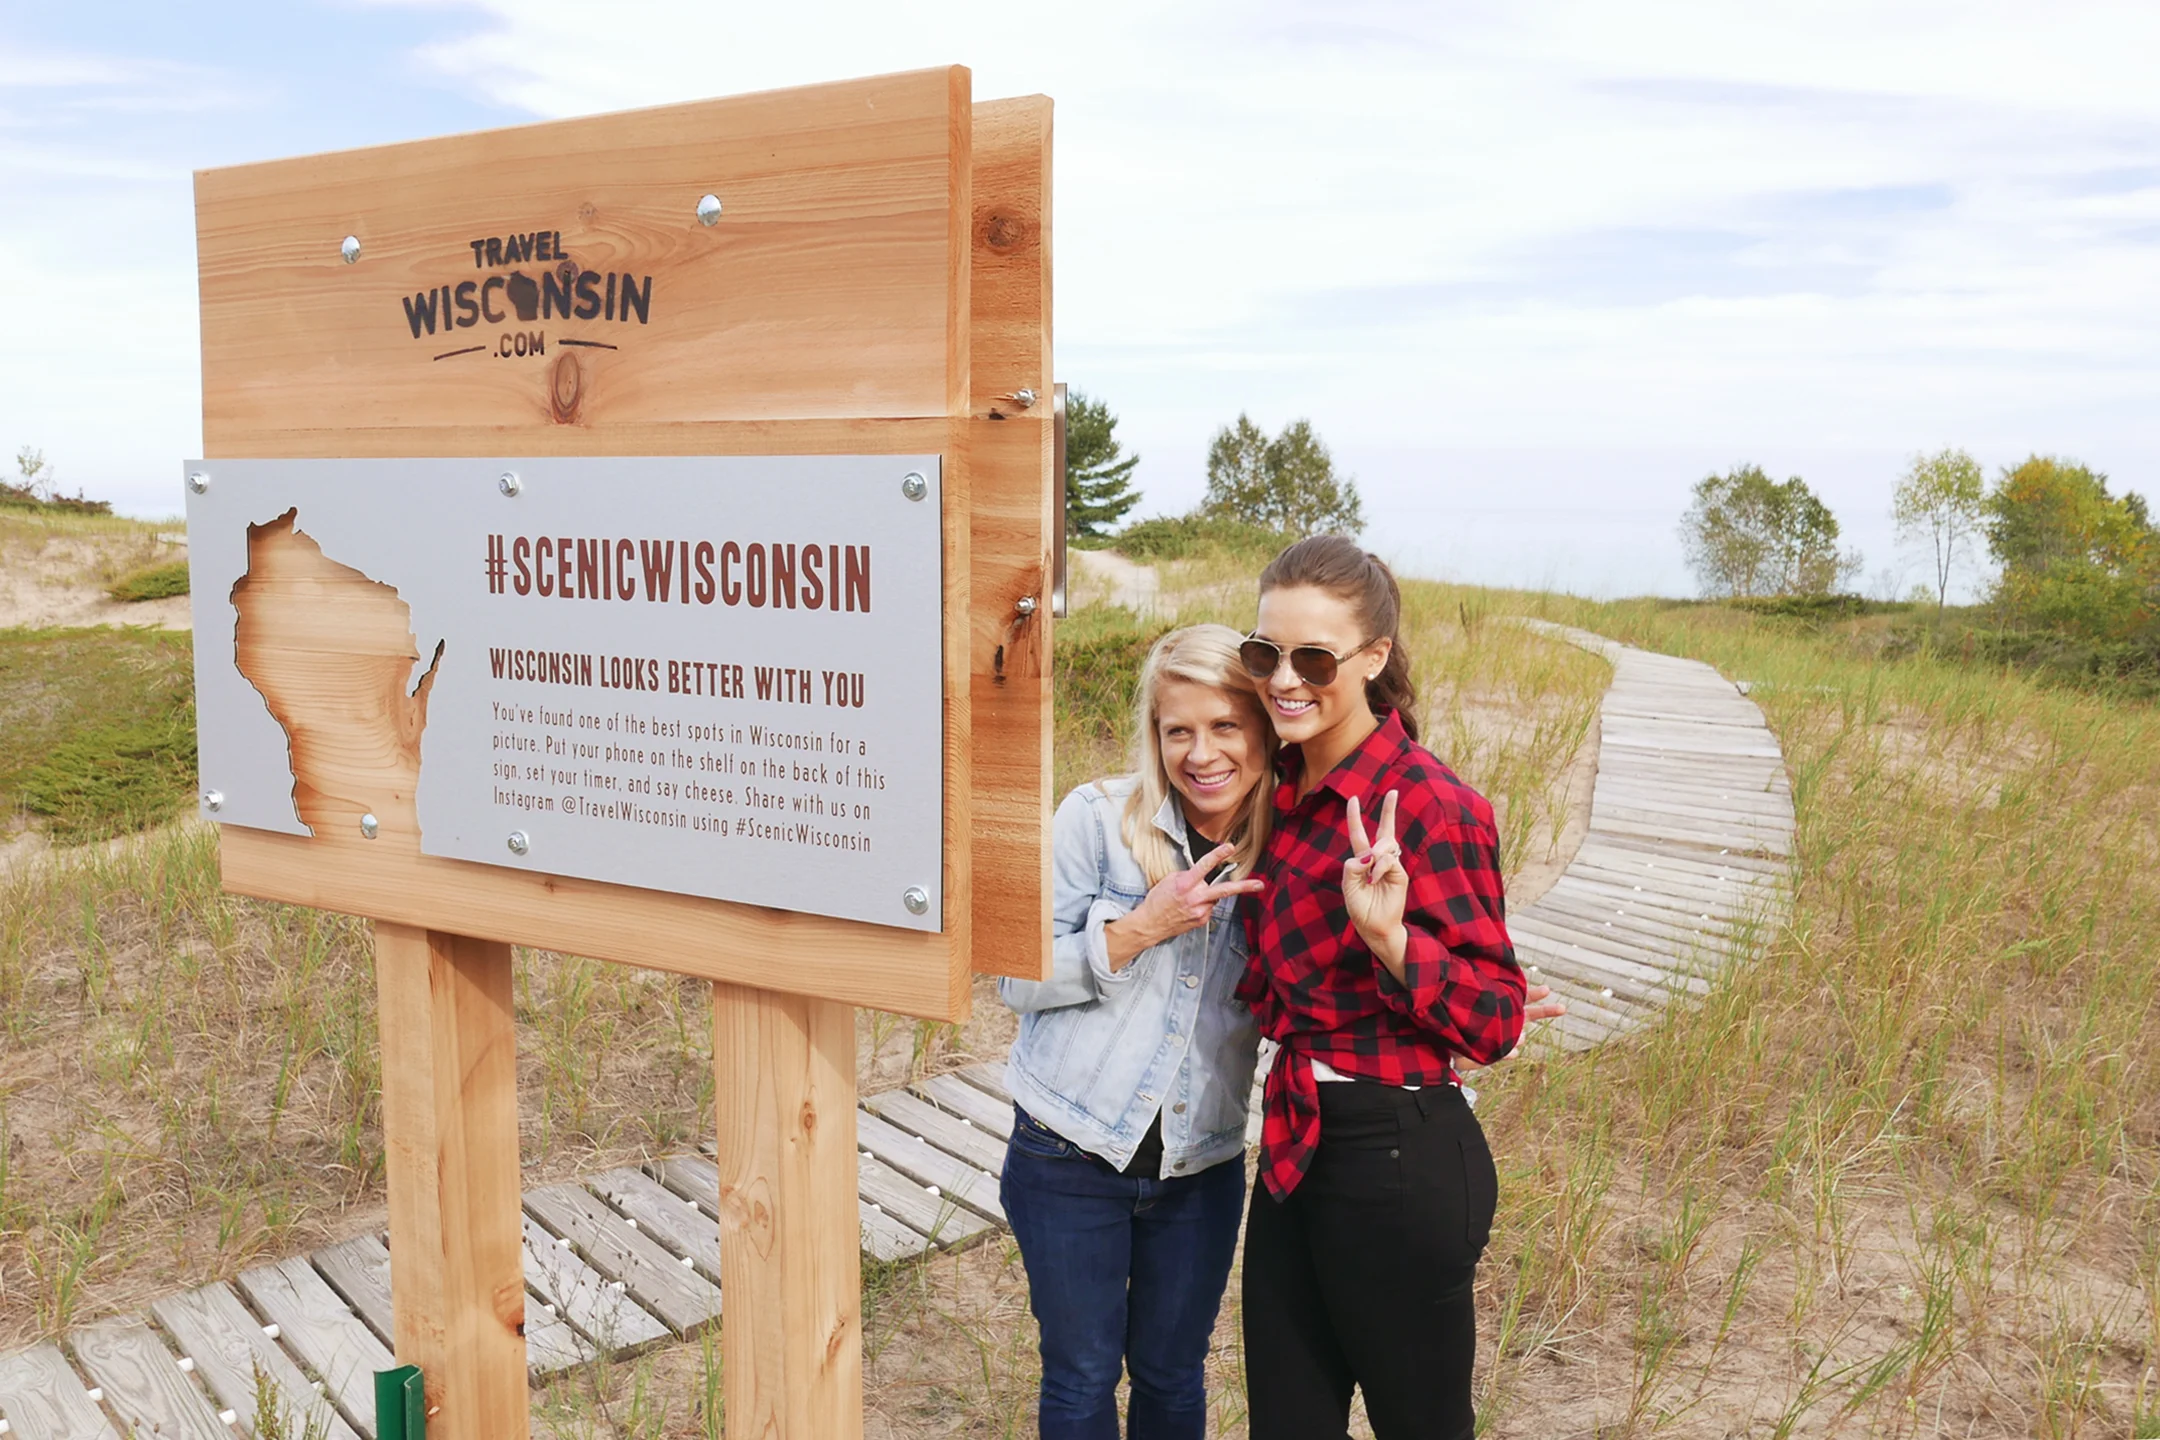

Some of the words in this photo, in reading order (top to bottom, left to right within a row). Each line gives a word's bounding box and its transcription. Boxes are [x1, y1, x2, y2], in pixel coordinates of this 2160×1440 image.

[470, 231, 569, 268] TRAVEL
[493, 330, 545, 358] .COM
[485, 534, 871, 613] #SCENICWISCONSIN
[489, 647, 592, 687] WISCONSIN
[600, 655, 659, 692] LOOKS
[668, 660, 745, 699] BETTER
[754, 666, 812, 705] WITH
[821, 670, 864, 708] YOU
[493, 701, 534, 723] You've
[539, 705, 573, 728] found
[579, 714, 600, 729] one
[607, 712, 620, 732] of
[625, 714, 646, 734] the
[652, 716, 681, 738] best
[688, 720, 724, 743] spots
[730, 724, 742, 744] in
[750, 725, 822, 752] Wisconsin
[830, 731, 850, 754] for
[858, 741, 866, 756] a
[493, 731, 541, 753] picture.
[546, 735, 566, 755] Put
[572, 743, 599, 759] your
[605, 742, 644, 763] phone
[651, 751, 665, 766] on
[672, 748, 693, 769] the
[700, 751, 734, 774] shelf
[740, 760, 755, 776] on
[763, 758, 785, 779] the
[793, 760, 828, 784] back
[835, 765, 850, 787] of
[857, 767, 885, 790] this
[494, 785, 554, 811] Instagram
[561, 795, 687, 829] @TravelWisconsin
[693, 813, 728, 836] using
[735, 817, 871, 852] #ScenicWisconsin
[526, 764, 545, 782] set
[550, 769, 577, 786] your
[628, 775, 650, 795] and
[657, 782, 678, 800] say
[685, 779, 738, 805] cheese.
[745, 786, 785, 810] Share
[792, 793, 824, 815] with
[831, 802, 846, 818] us
[854, 805, 870, 820] on
